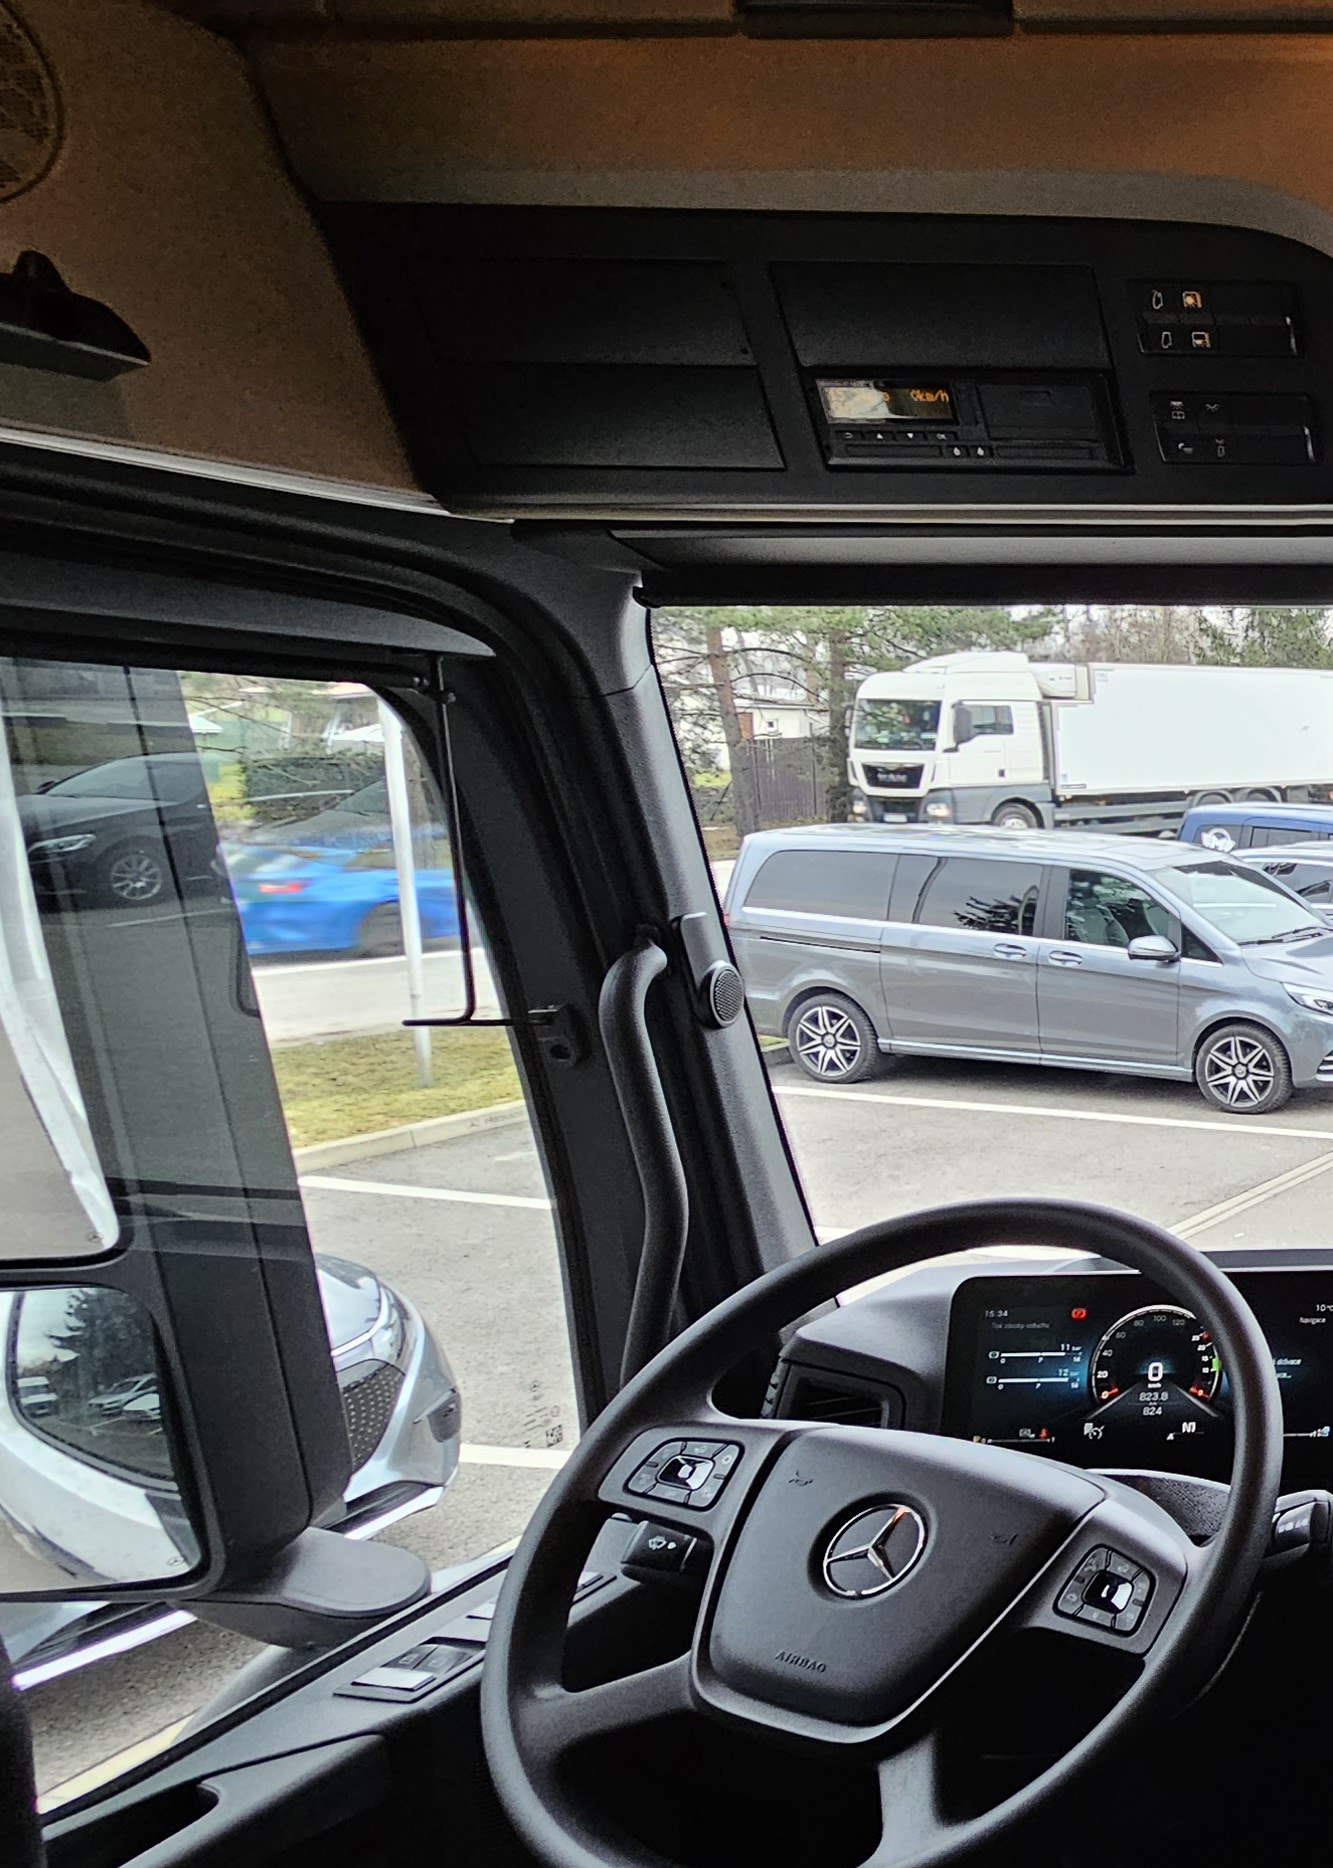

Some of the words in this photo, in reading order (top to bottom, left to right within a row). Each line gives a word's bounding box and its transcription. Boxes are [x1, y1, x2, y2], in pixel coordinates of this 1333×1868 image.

[1101, 1349, 1113, 1357] 40
[1097, 1370, 1109, 1378] 20
[1148, 1362, 1163, 1381] 0
[1139, 1392, 1169, 1401] 823.8
[1142, 1407, 1163, 1415] 824
[775, 1651, 827, 1673] AIRBAG
